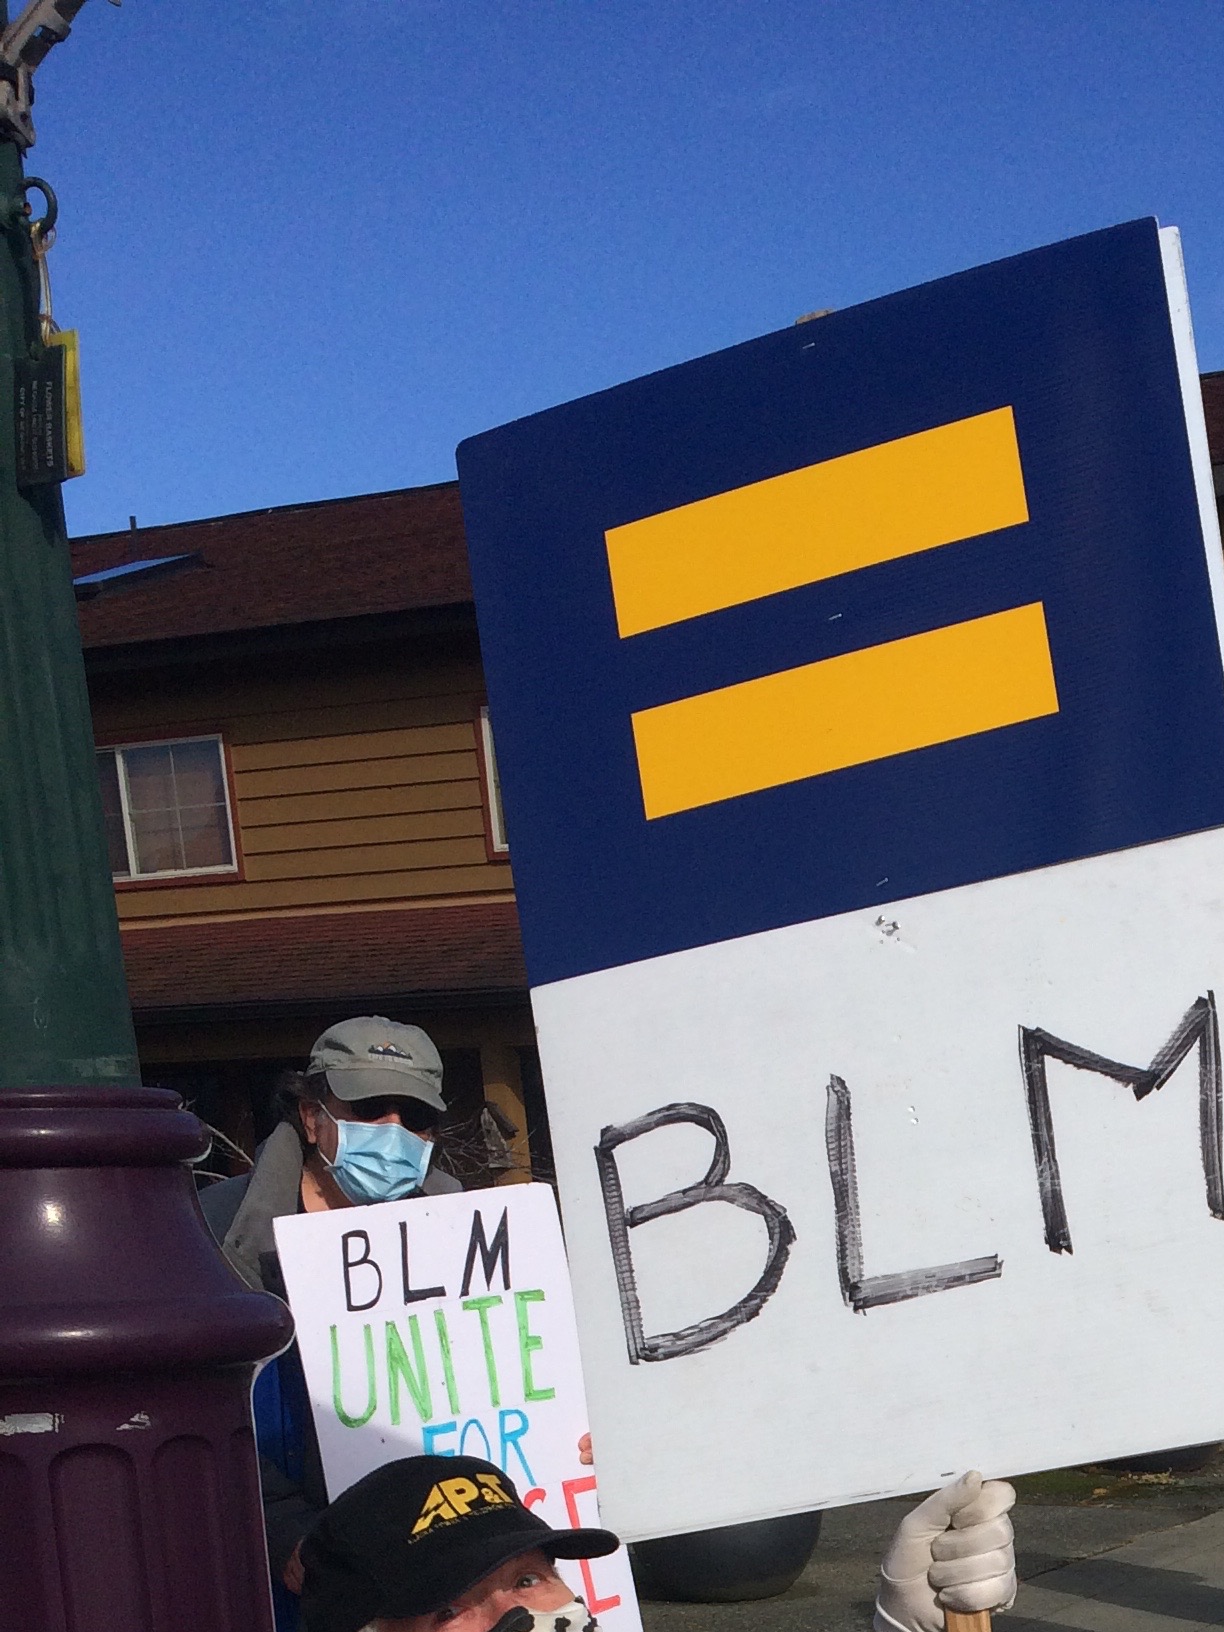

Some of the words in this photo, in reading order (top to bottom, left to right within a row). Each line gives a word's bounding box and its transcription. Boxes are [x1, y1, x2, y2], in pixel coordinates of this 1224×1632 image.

[340, 1206, 511, 1312] BLM
[330, 1288, 556, 1429] UNITE
[411, 1473, 515, 1535] AP&T
